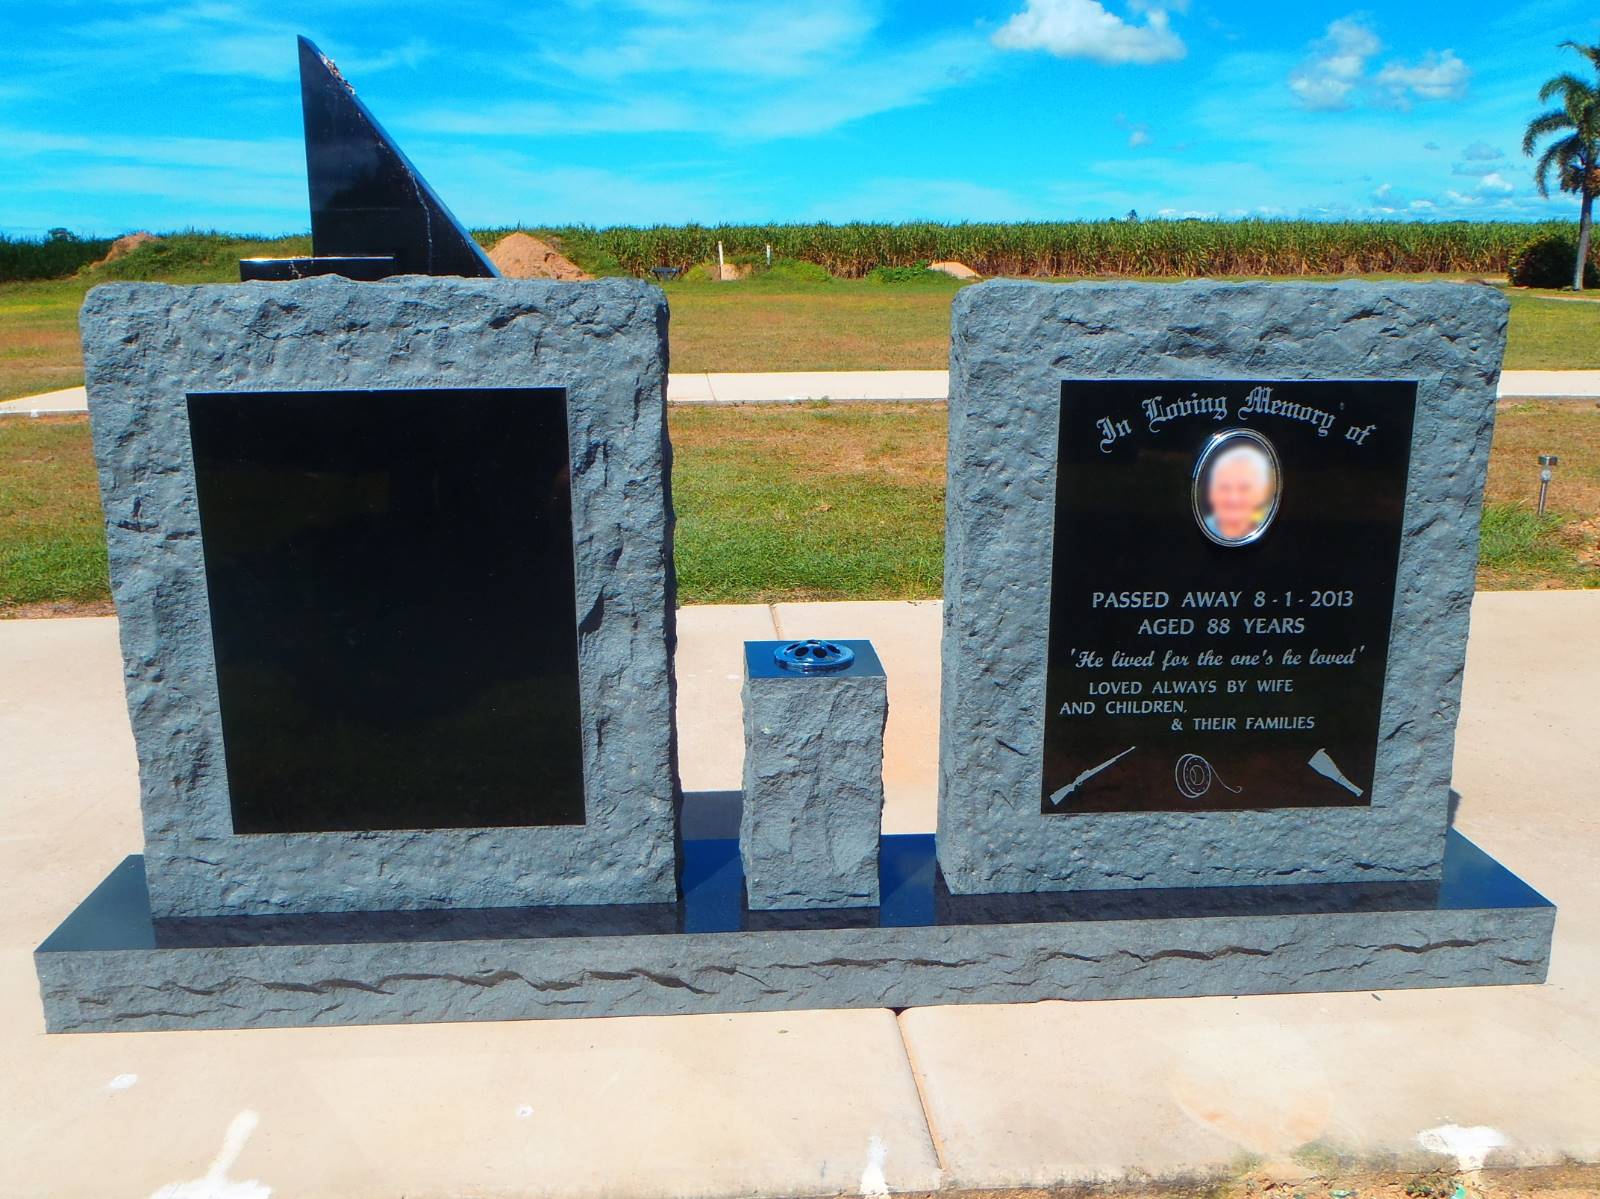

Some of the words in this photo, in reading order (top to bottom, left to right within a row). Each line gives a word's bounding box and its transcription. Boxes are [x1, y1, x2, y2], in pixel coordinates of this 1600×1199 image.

[1096, 415, 1132, 453] In
[1142, 392, 1228, 433] Loving
[1237, 386, 1336, 437] Memory
[1345, 423, 1377, 446] of
[1092, 591, 1169, 608] PASSED
[1181, 591, 1242, 608] AWAY
[1138, 619, 1195, 635] AGED
[1207, 618, 1231, 635] 88
[1243, 617, 1305, 635] YEARS
[1111, 650, 1155, 668] lived
[1161, 649, 1190, 672] for
[1197, 649, 1223, 667] the
[1230, 649, 1274, 666] one's
[1281, 648, 1303, 666] he
[1089, 681, 1143, 695] LOVED
[1152, 680, 1217, 694] ALWAYS
[1227, 680, 1247, 693] BY
[1257, 679, 1294, 692] WIFE
[1059, 702, 1096, 715] AND
[1171, 718, 1184, 731] &
[1192, 717, 1236, 730] THEIR
[1245, 716, 1315, 730] FAMILIES
